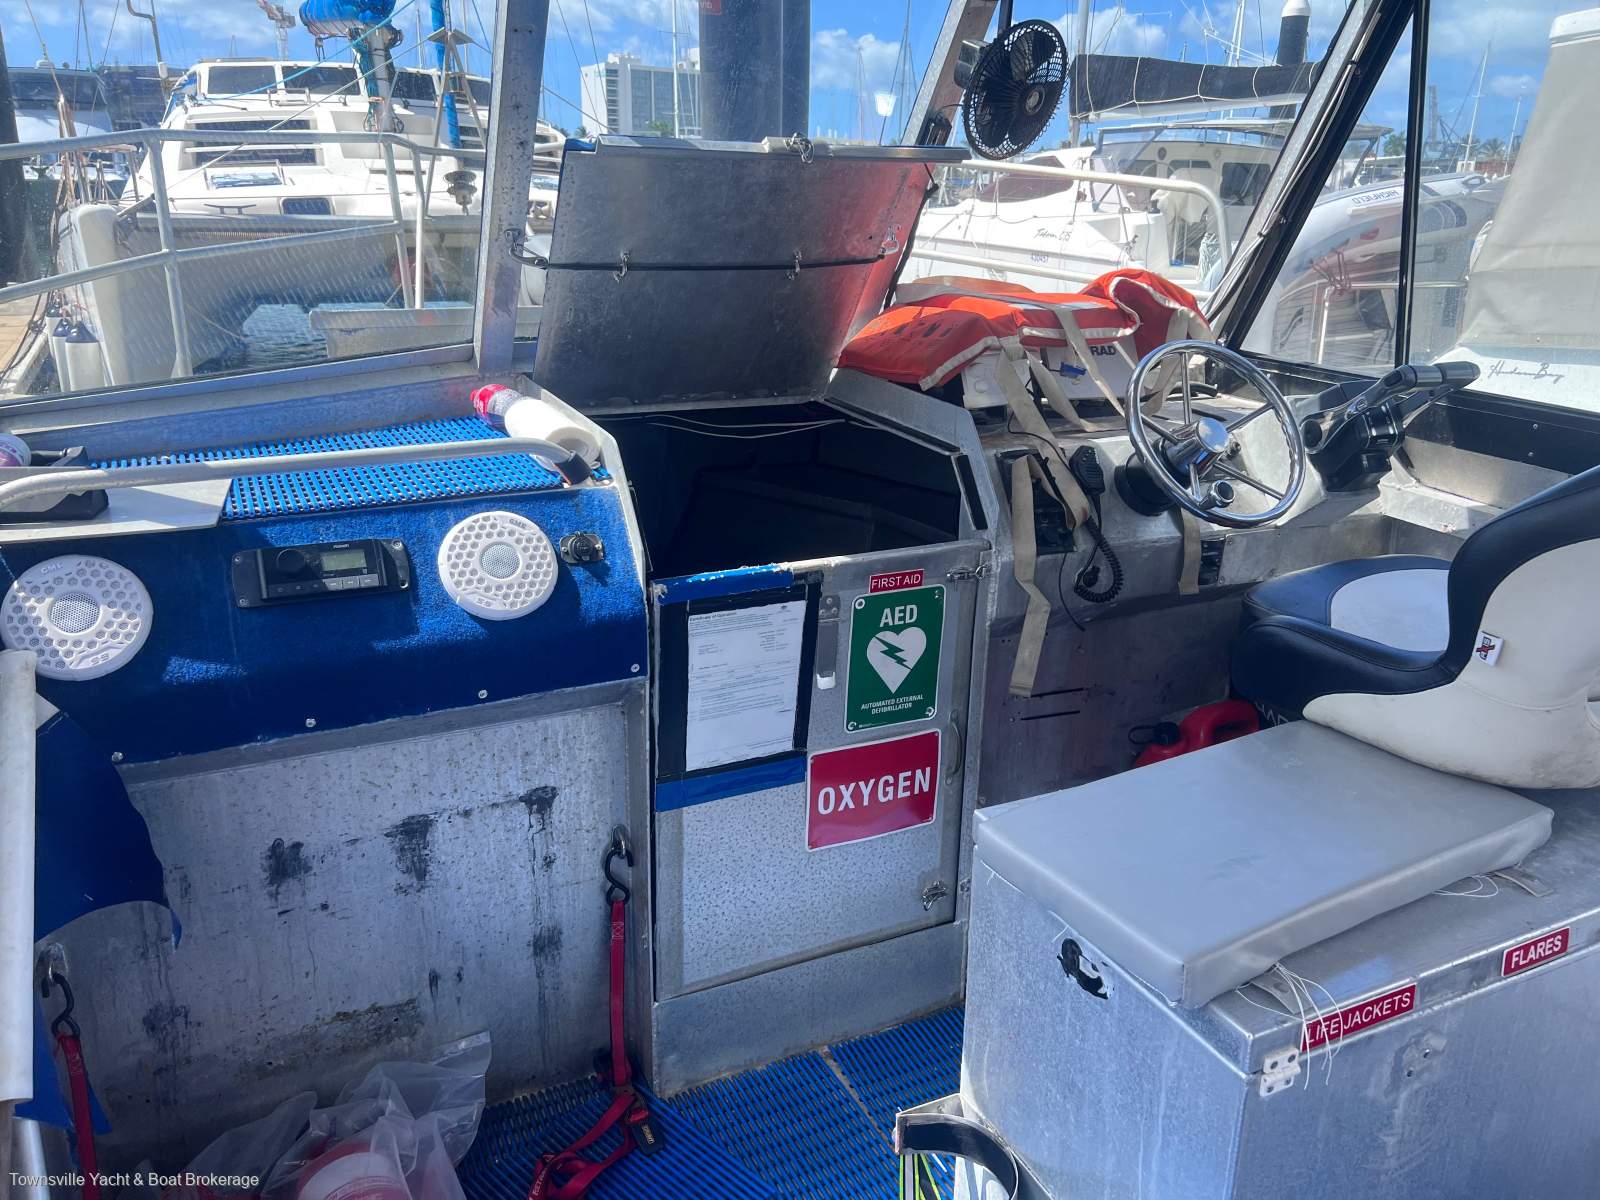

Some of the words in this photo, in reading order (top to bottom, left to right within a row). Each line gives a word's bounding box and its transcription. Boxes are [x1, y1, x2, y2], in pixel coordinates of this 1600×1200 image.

[871, 576, 902, 589] FIRST
[903, 574, 921, 584] AID
[880, 604, 918, 628] AED
[861, 699, 896, 710] AUTOMATED
[896, 694, 924, 703] EXTERNAL
[871, 702, 913, 715] DEFIBRILLATOR
[817, 766, 931, 815] OXYGEN
[1511, 935, 1562, 969] FLARES
[1306, 1017, 1340, 1044] LIFE
[1343, 992, 1411, 1030] JACKETS
